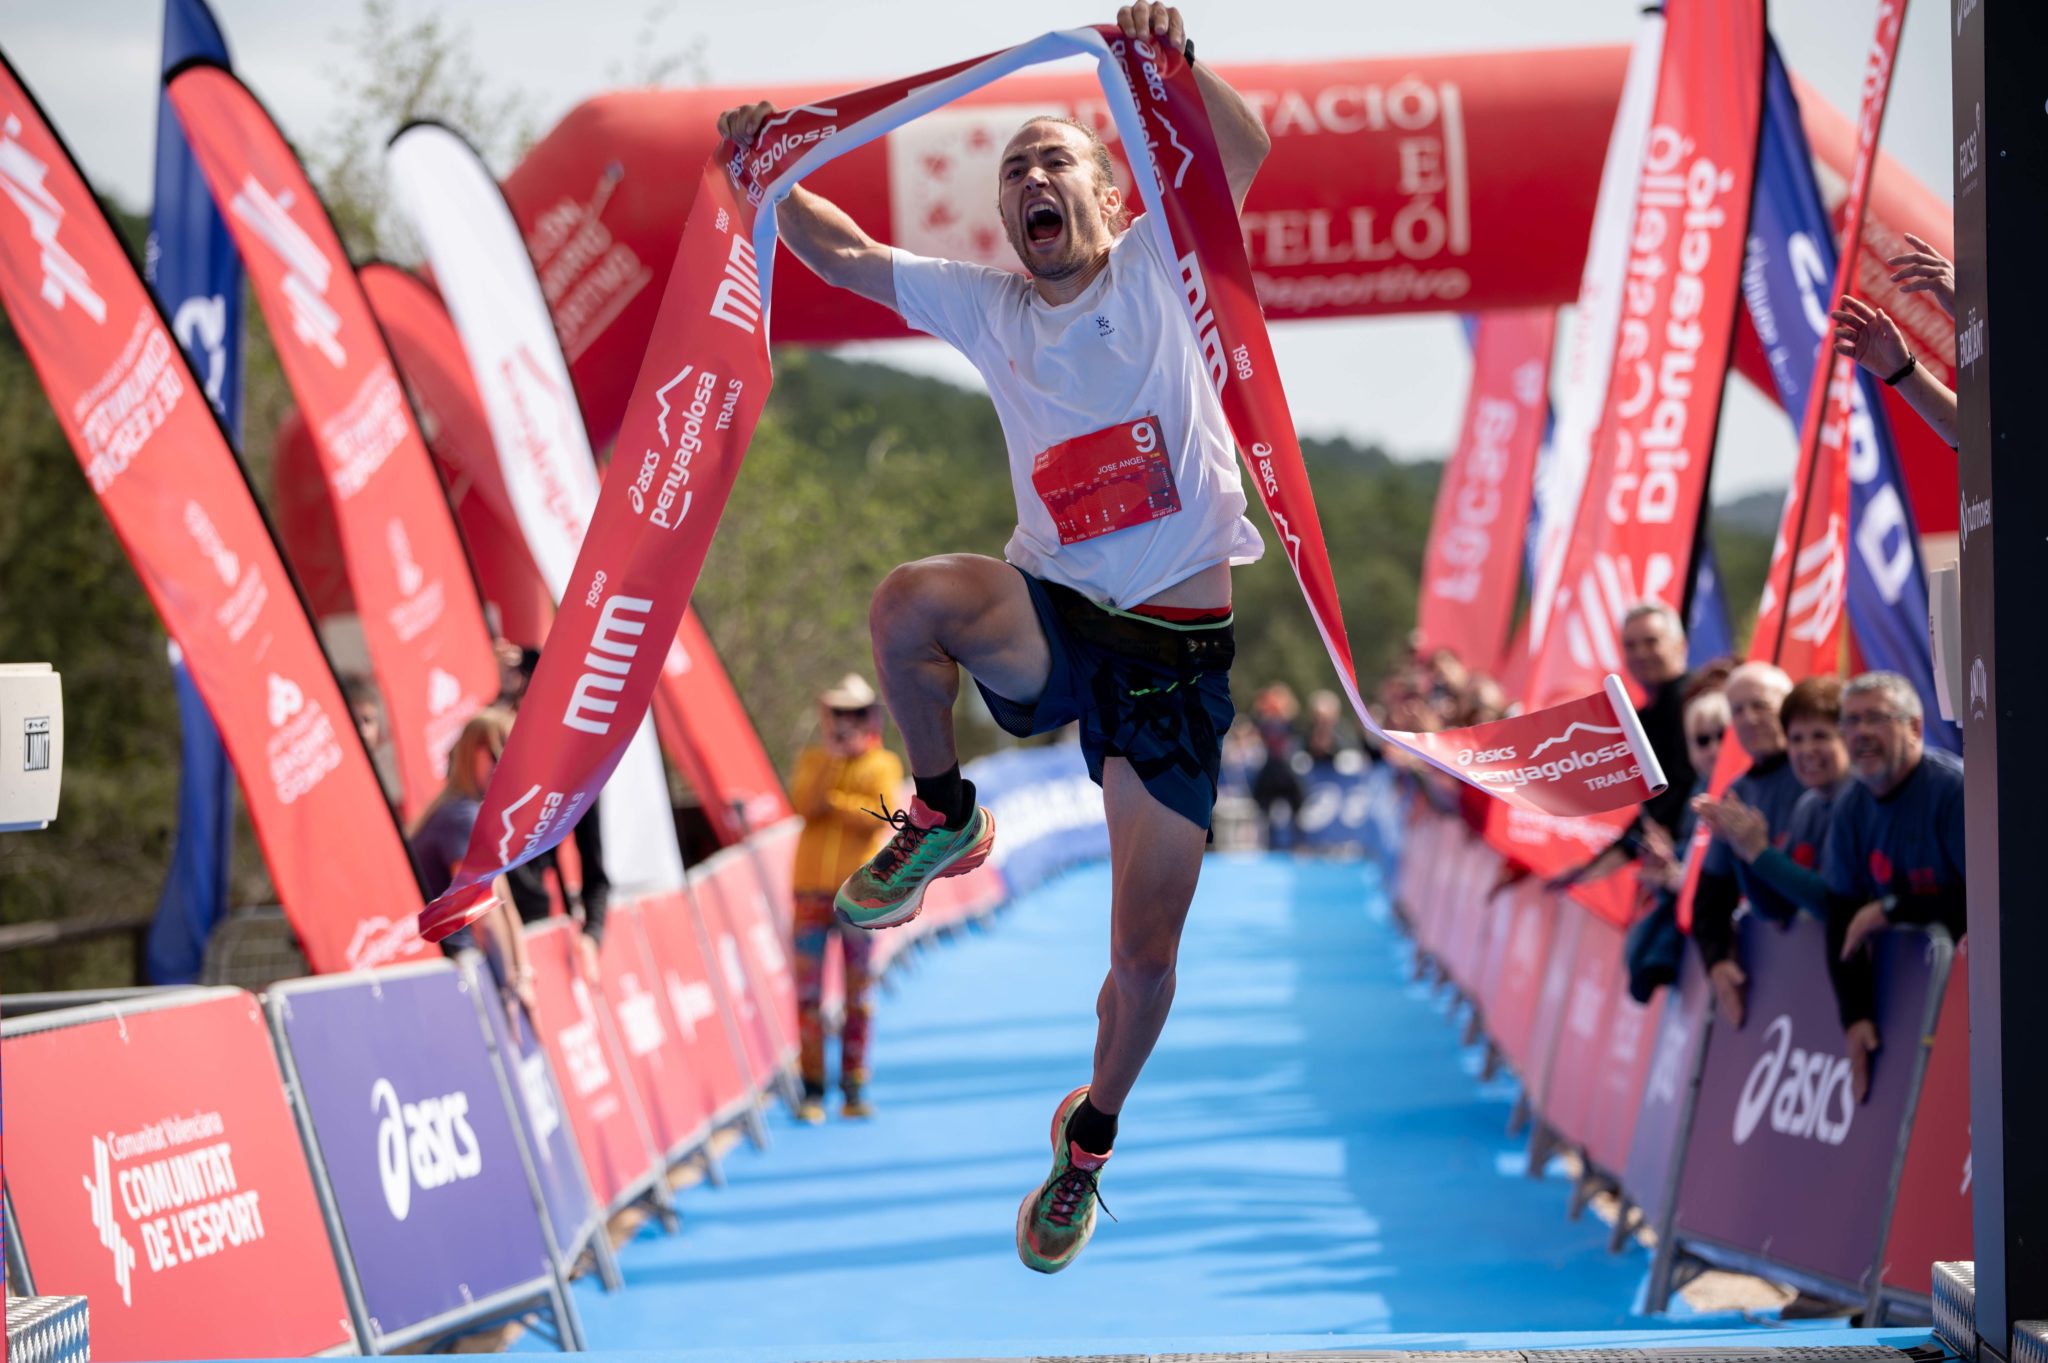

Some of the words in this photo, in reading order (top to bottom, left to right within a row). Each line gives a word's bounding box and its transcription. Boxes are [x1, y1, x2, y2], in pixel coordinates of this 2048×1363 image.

[1143, 62, 1168, 102] asics
[1233, 344, 1254, 380] 1999
[715, 379, 743, 432] TRAILS
[650, 372, 717, 529] penyagolosa
[1132, 422, 1156, 453] 9
[635, 450, 660, 500] asics
[1098, 463, 1118, 475] JOSE
[1120, 456, 1147, 468] ANGEL
[1257, 459, 1278, 498] asics
[586, 570, 607, 608] 1999
[1467, 741, 1632, 787] penyagolosa
[1476, 746, 1516, 763] asics
[1584, 766, 1642, 791] TRAILS
[1770, 1048, 1855, 1146] asics
[107, 1124, 164, 1161] Comunitat
[165, 1110, 224, 1145] Valenciana
[408, 1090, 482, 1190] asics
[119, 1142, 238, 1221] COMUNITAT
[141, 1221, 178, 1273] DE
[178, 1190, 266, 1268] L'ESPORT
